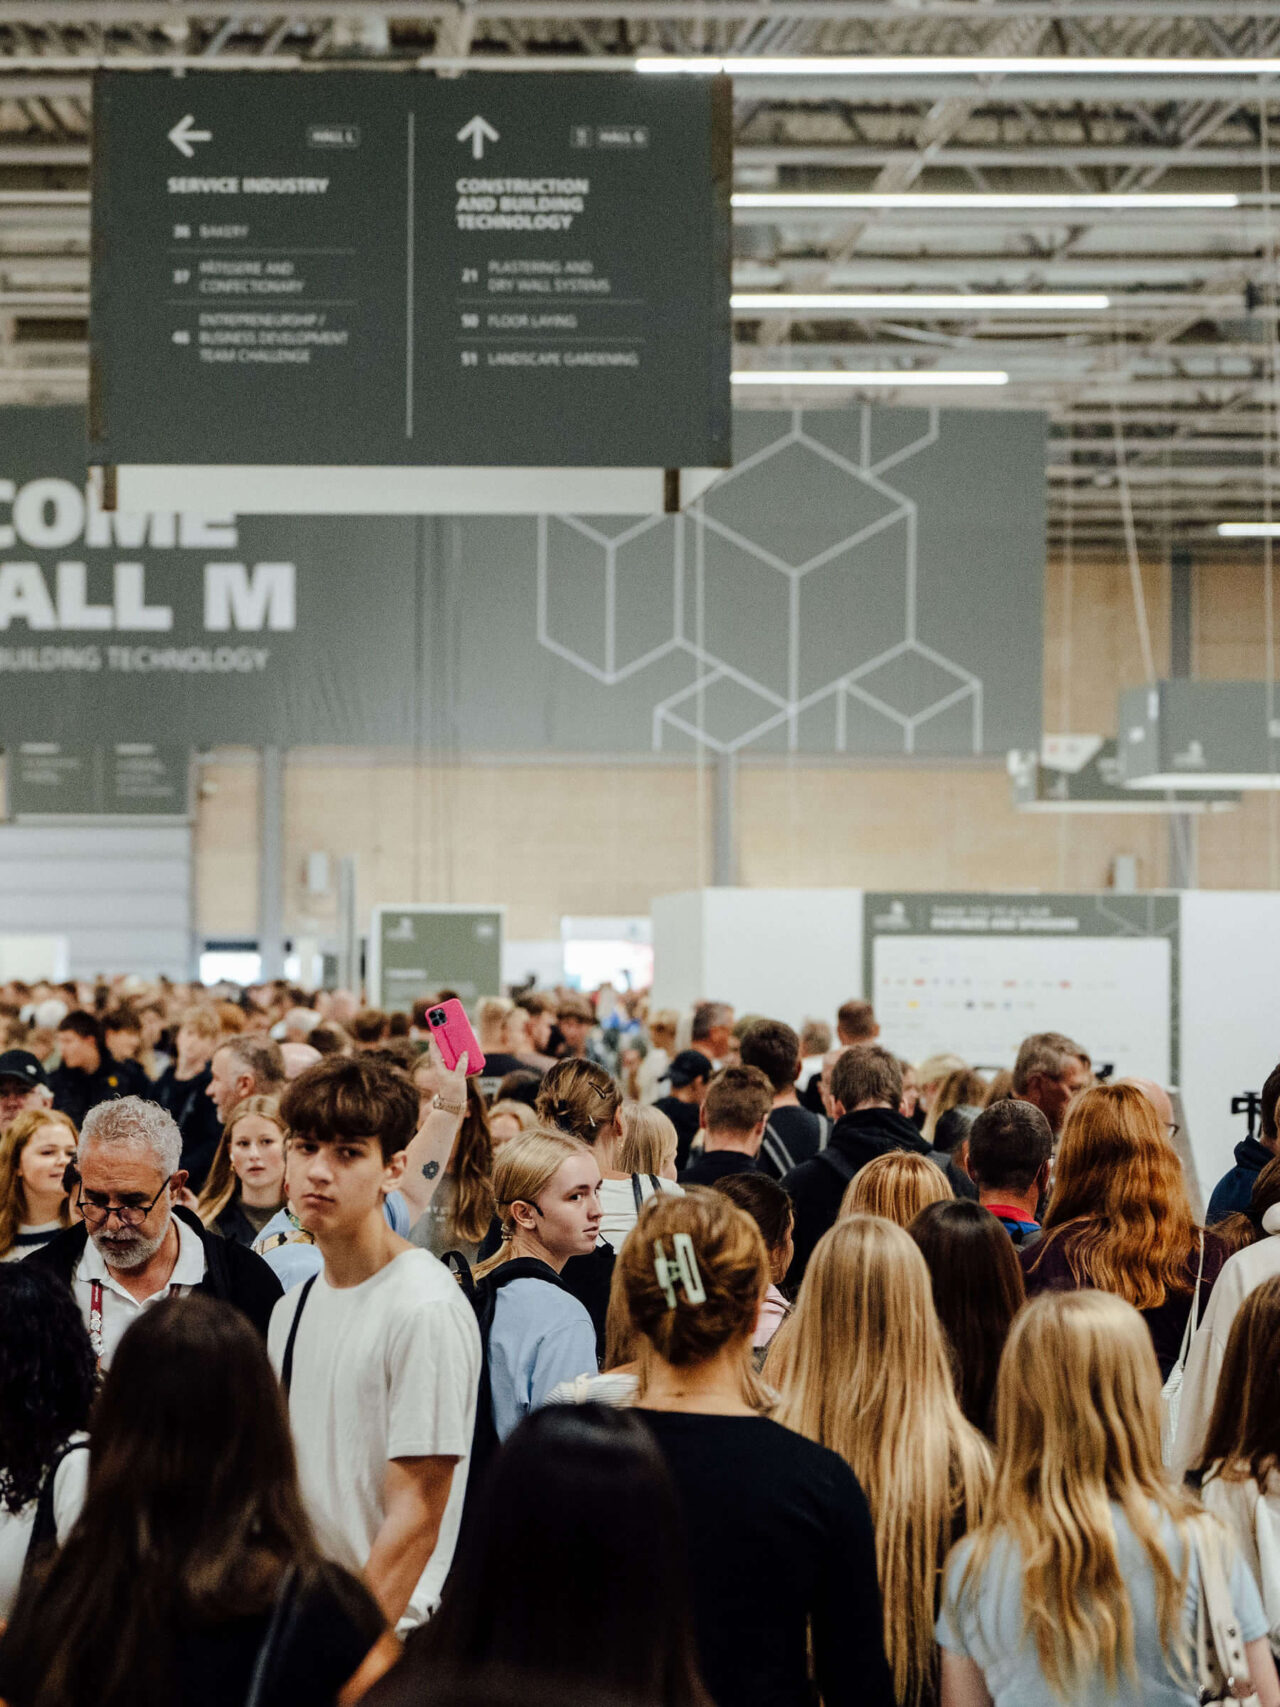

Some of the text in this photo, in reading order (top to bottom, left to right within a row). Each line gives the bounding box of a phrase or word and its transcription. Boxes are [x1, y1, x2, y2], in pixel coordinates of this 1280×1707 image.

[168, 177, 329, 194] SERVICE INDUSTRY
[456, 178, 590, 195] CONSTRUCTION
[456, 195, 585, 213] AND BUILDING
[456, 213, 573, 231] TECHNOLOGY
[199, 224, 249, 239] BAKERY
[265, 260, 294, 276] AND
[487, 259, 594, 275] PLASTERING AND
[487, 277, 611, 293] DRY WALL SYSTEMS
[487, 313, 529, 329] FLOOR
[530, 313, 578, 329] LAYING
[199, 330, 349, 345] BUSINESS DEVELOPMENT
[199, 348, 311, 364] TEAM CHALLENGE
[487, 351, 562, 367] LANDSCAPE
[563, 351, 640, 367] GARDENING
[203, 561, 297, 633] M
[107, 646, 269, 674] TECHNOLOGY
